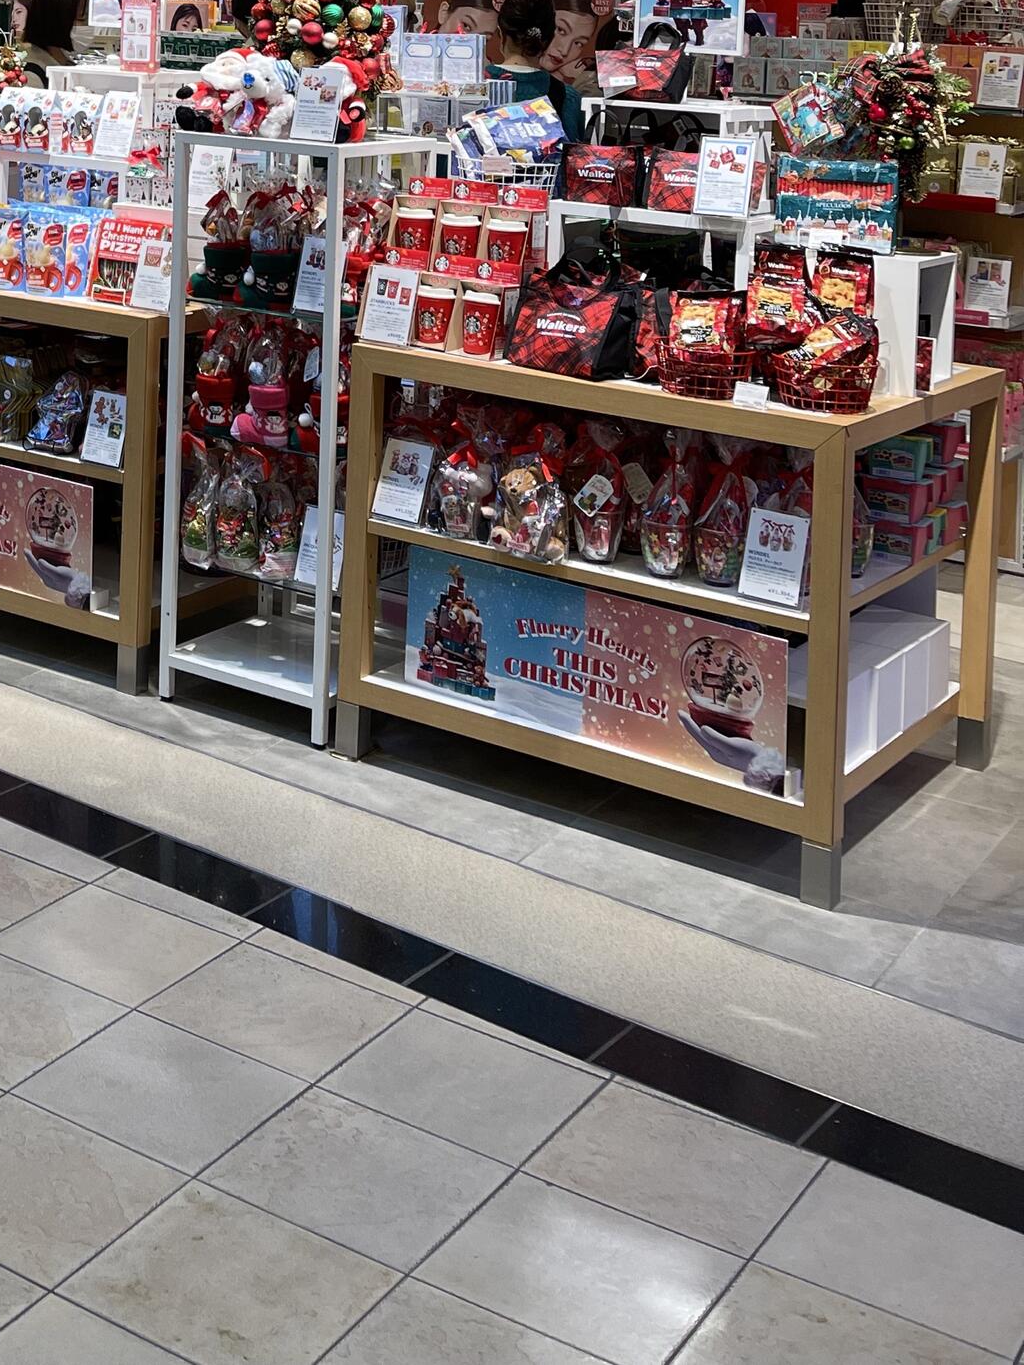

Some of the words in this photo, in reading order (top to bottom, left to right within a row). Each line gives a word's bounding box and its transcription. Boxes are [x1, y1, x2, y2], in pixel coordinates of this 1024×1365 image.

[103, 221, 115, 231] All
[117, 224, 121, 232] I
[123, 224, 144, 235] Want
[146, 227, 158, 237] for
[101, 231, 143, 244] Christma
[99, 239, 140, 255] PIZZ
[768, 262, 795, 270] Walkers
[536, 318, 586, 333] Walkers
[515, 618, 584, 645] Flurry
[587, 627, 658, 675] Hearts
[553, 647, 617, 683] THIS
[503, 656, 668, 723] CHRISTMAS!
